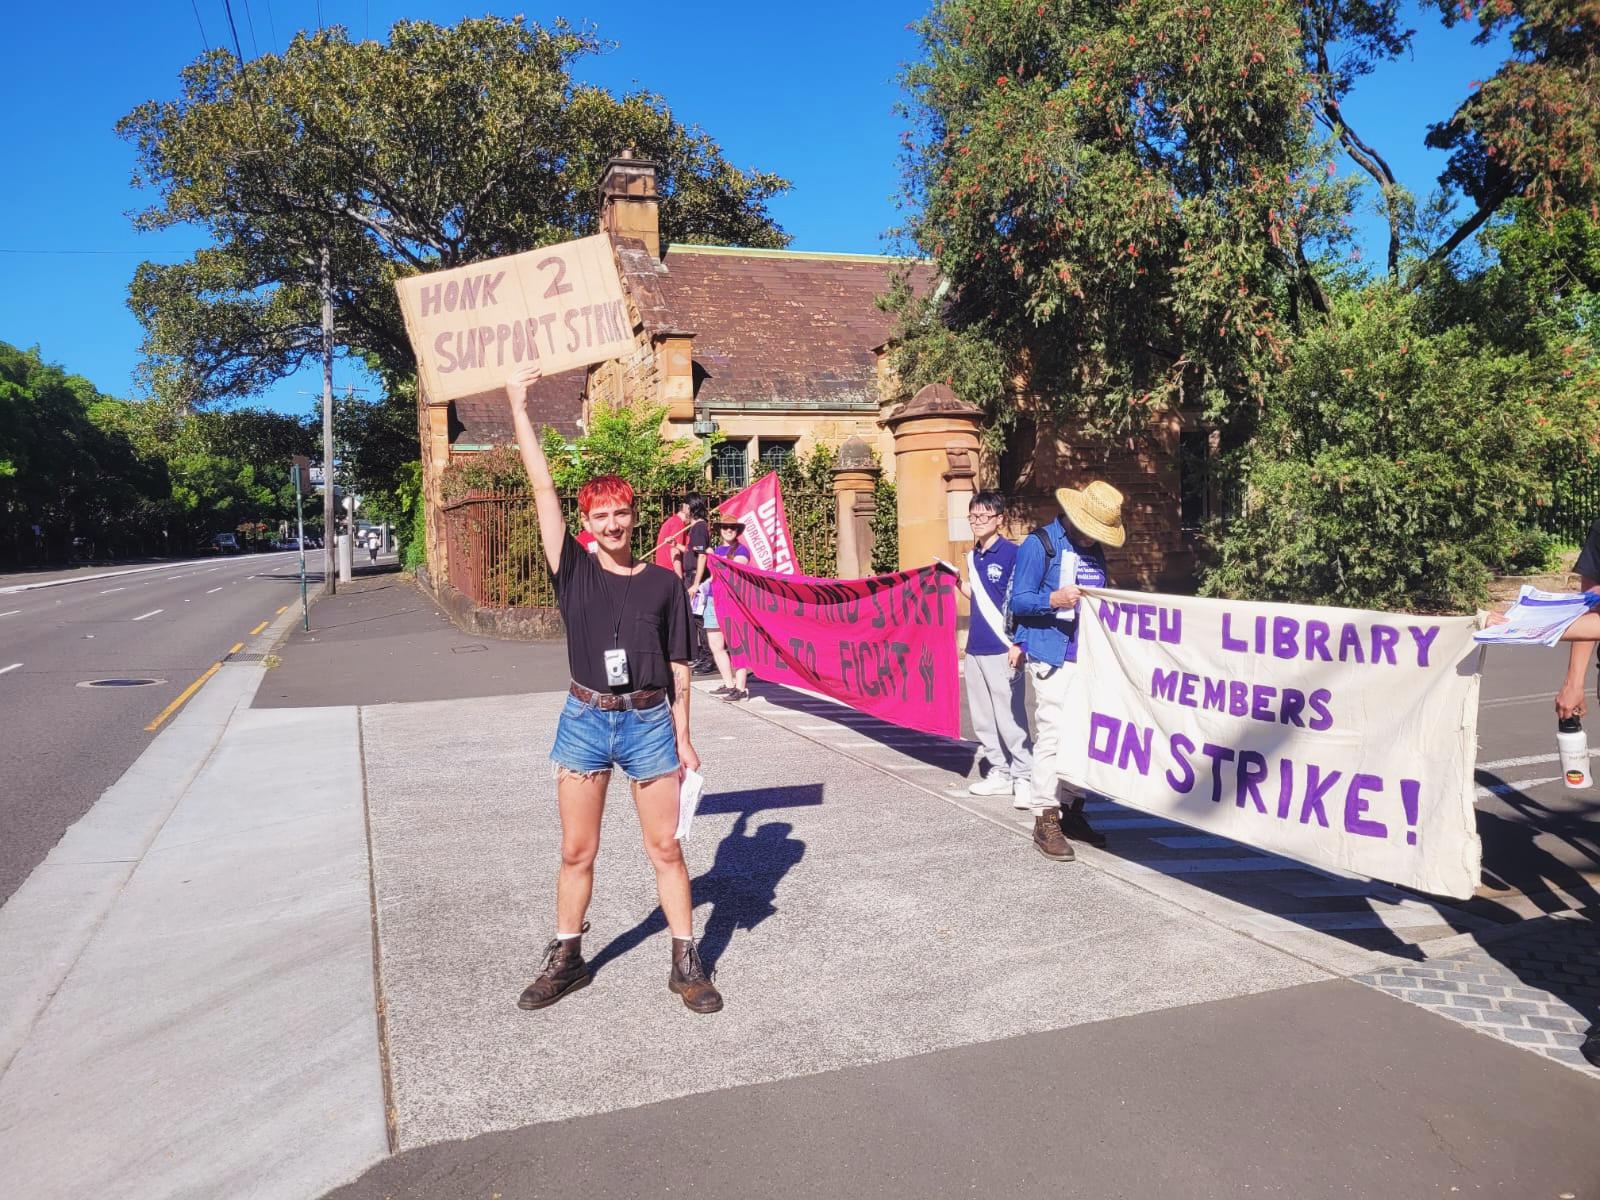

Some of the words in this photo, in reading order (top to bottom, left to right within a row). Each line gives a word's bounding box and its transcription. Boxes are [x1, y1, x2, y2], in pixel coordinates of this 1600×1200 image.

[420, 271, 506, 317] HONK
[536, 256, 573, 299] 2
[434, 312, 556, 373] SUPPORT
[1099, 599, 1182, 645] NTEU
[1221, 612, 1441, 668] LIBRARY
[1151, 667, 1335, 732] MEMBERS
[1088, 711, 1154, 777] ON
[1165, 732, 1421, 846] STRIKE!
